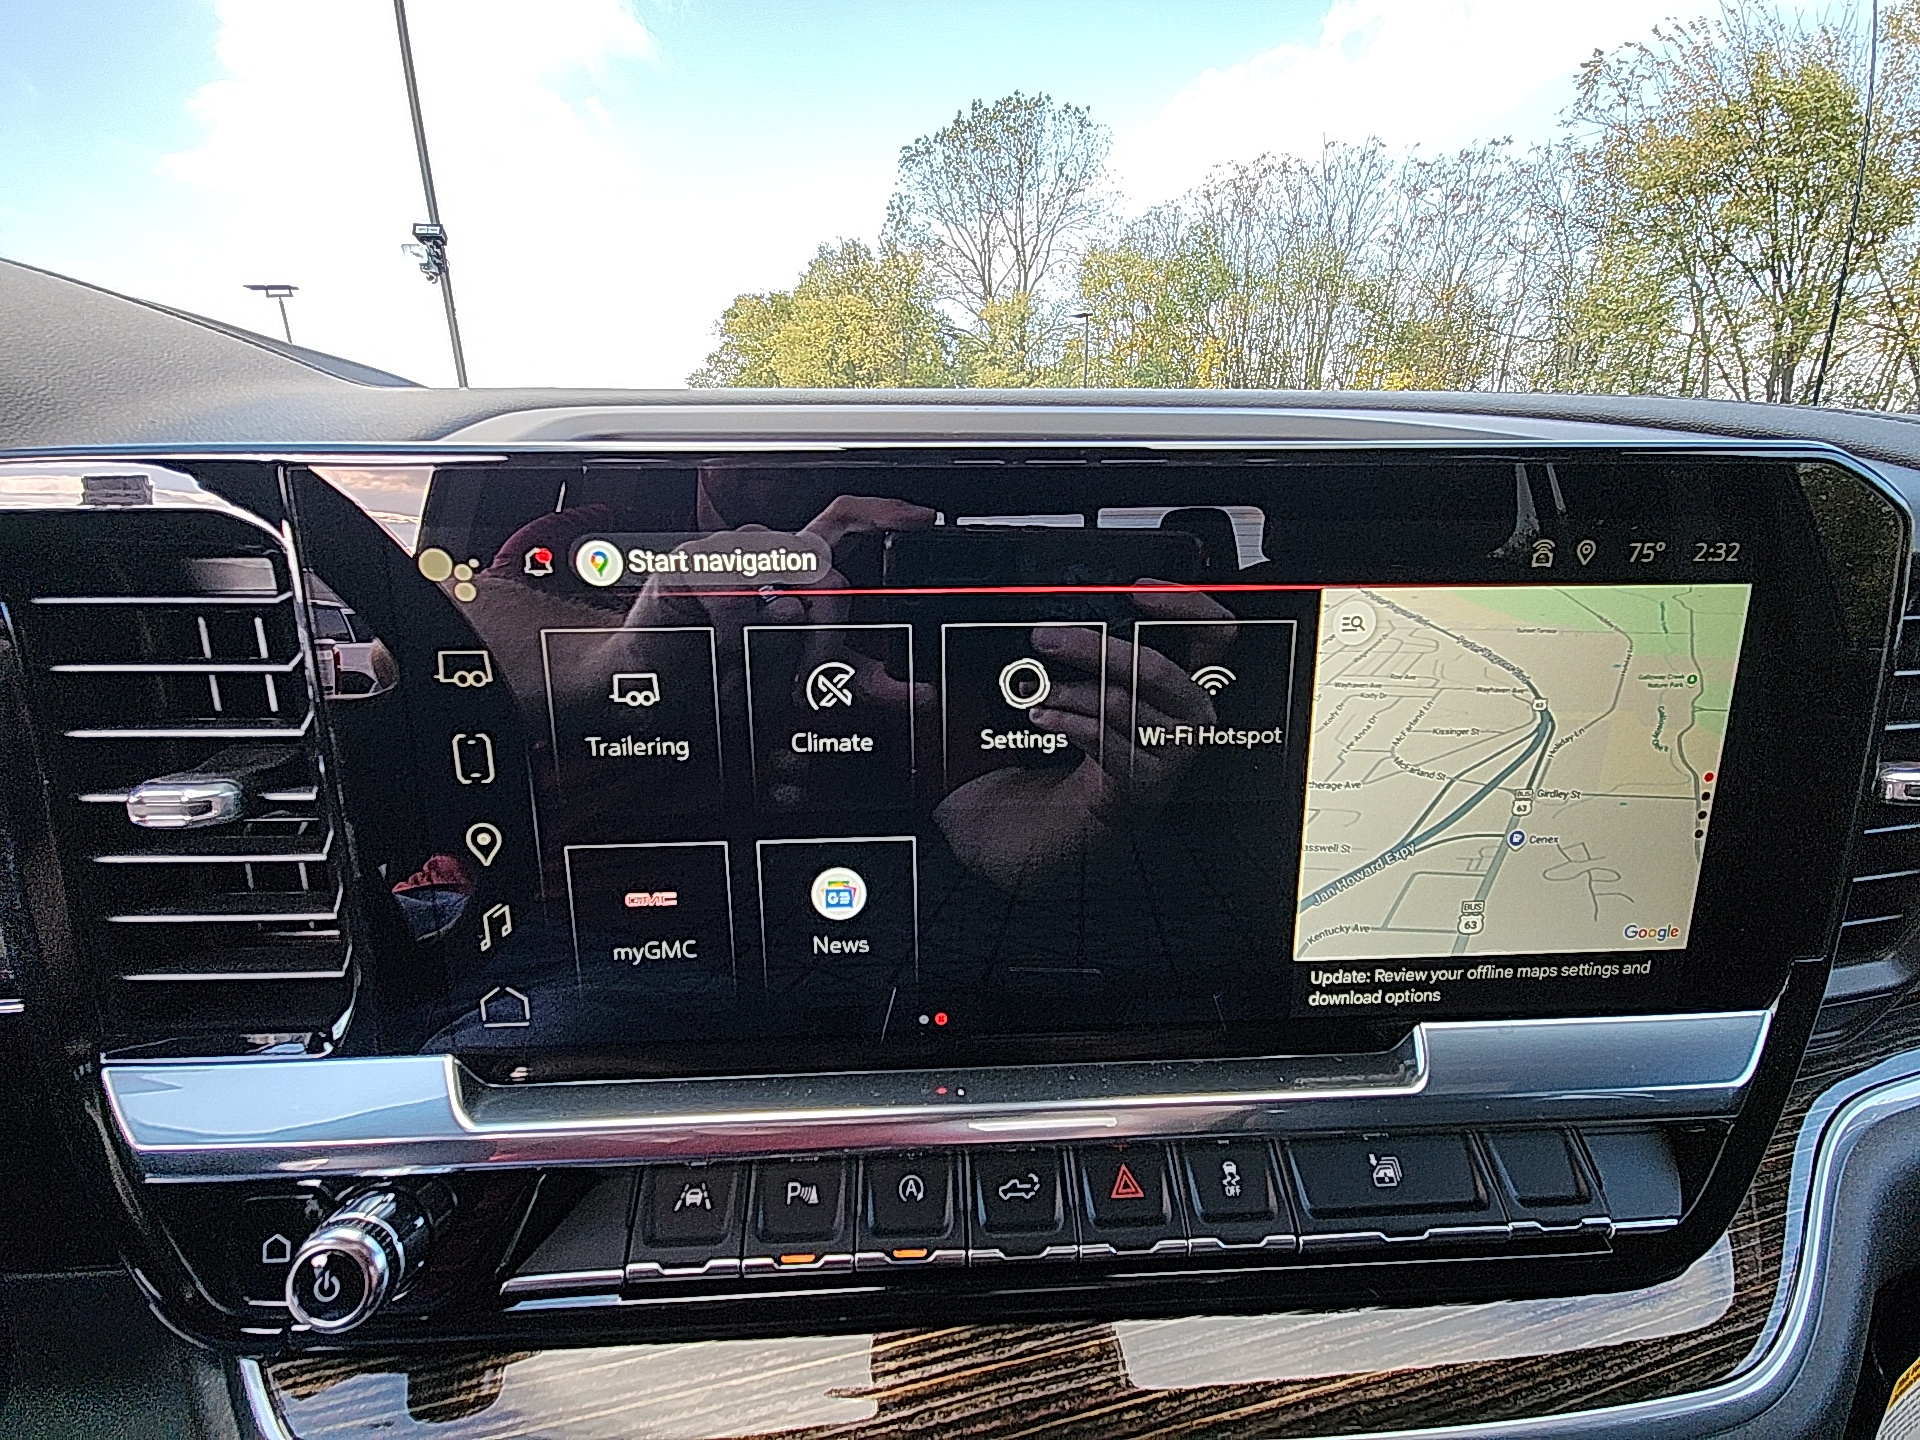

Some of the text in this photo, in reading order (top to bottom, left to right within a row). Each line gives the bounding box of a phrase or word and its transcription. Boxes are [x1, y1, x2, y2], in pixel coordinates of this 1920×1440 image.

[1629, 542, 1666, 562] 75°
[1692, 542, 1740, 562] 2:32
[629, 548, 817, 577] Start navigation
[791, 732, 873, 753] Climate
[980, 728, 1068, 753] Settings
[1138, 725, 1283, 749] Wi-Fi Hotspot
[1432, 728, 1480, 738] Kissinger St
[584, 735, 690, 761] Trailering
[1344, 781, 1362, 789] Ave
[1516, 804, 1528, 812] 63
[1341, 844, 1352, 854] St
[1529, 836, 1559, 845] Cenex
[1313, 842, 1416, 906] Jan Howard Expy
[624, 891, 678, 908] GMC
[1463, 903, 1482, 911] BUS
[1307, 923, 1371, 946] Kentucky Ave
[1464, 920, 1478, 930] 63
[1624, 924, 1679, 941] Google
[613, 939, 698, 965] myGMC
[812, 935, 870, 955] News
[1310, 960, 1651, 987] Update: Review your offline maps settings and
[1308, 988, 1441, 1007] download options
[1225, 1184, 1241, 1197] OFF
